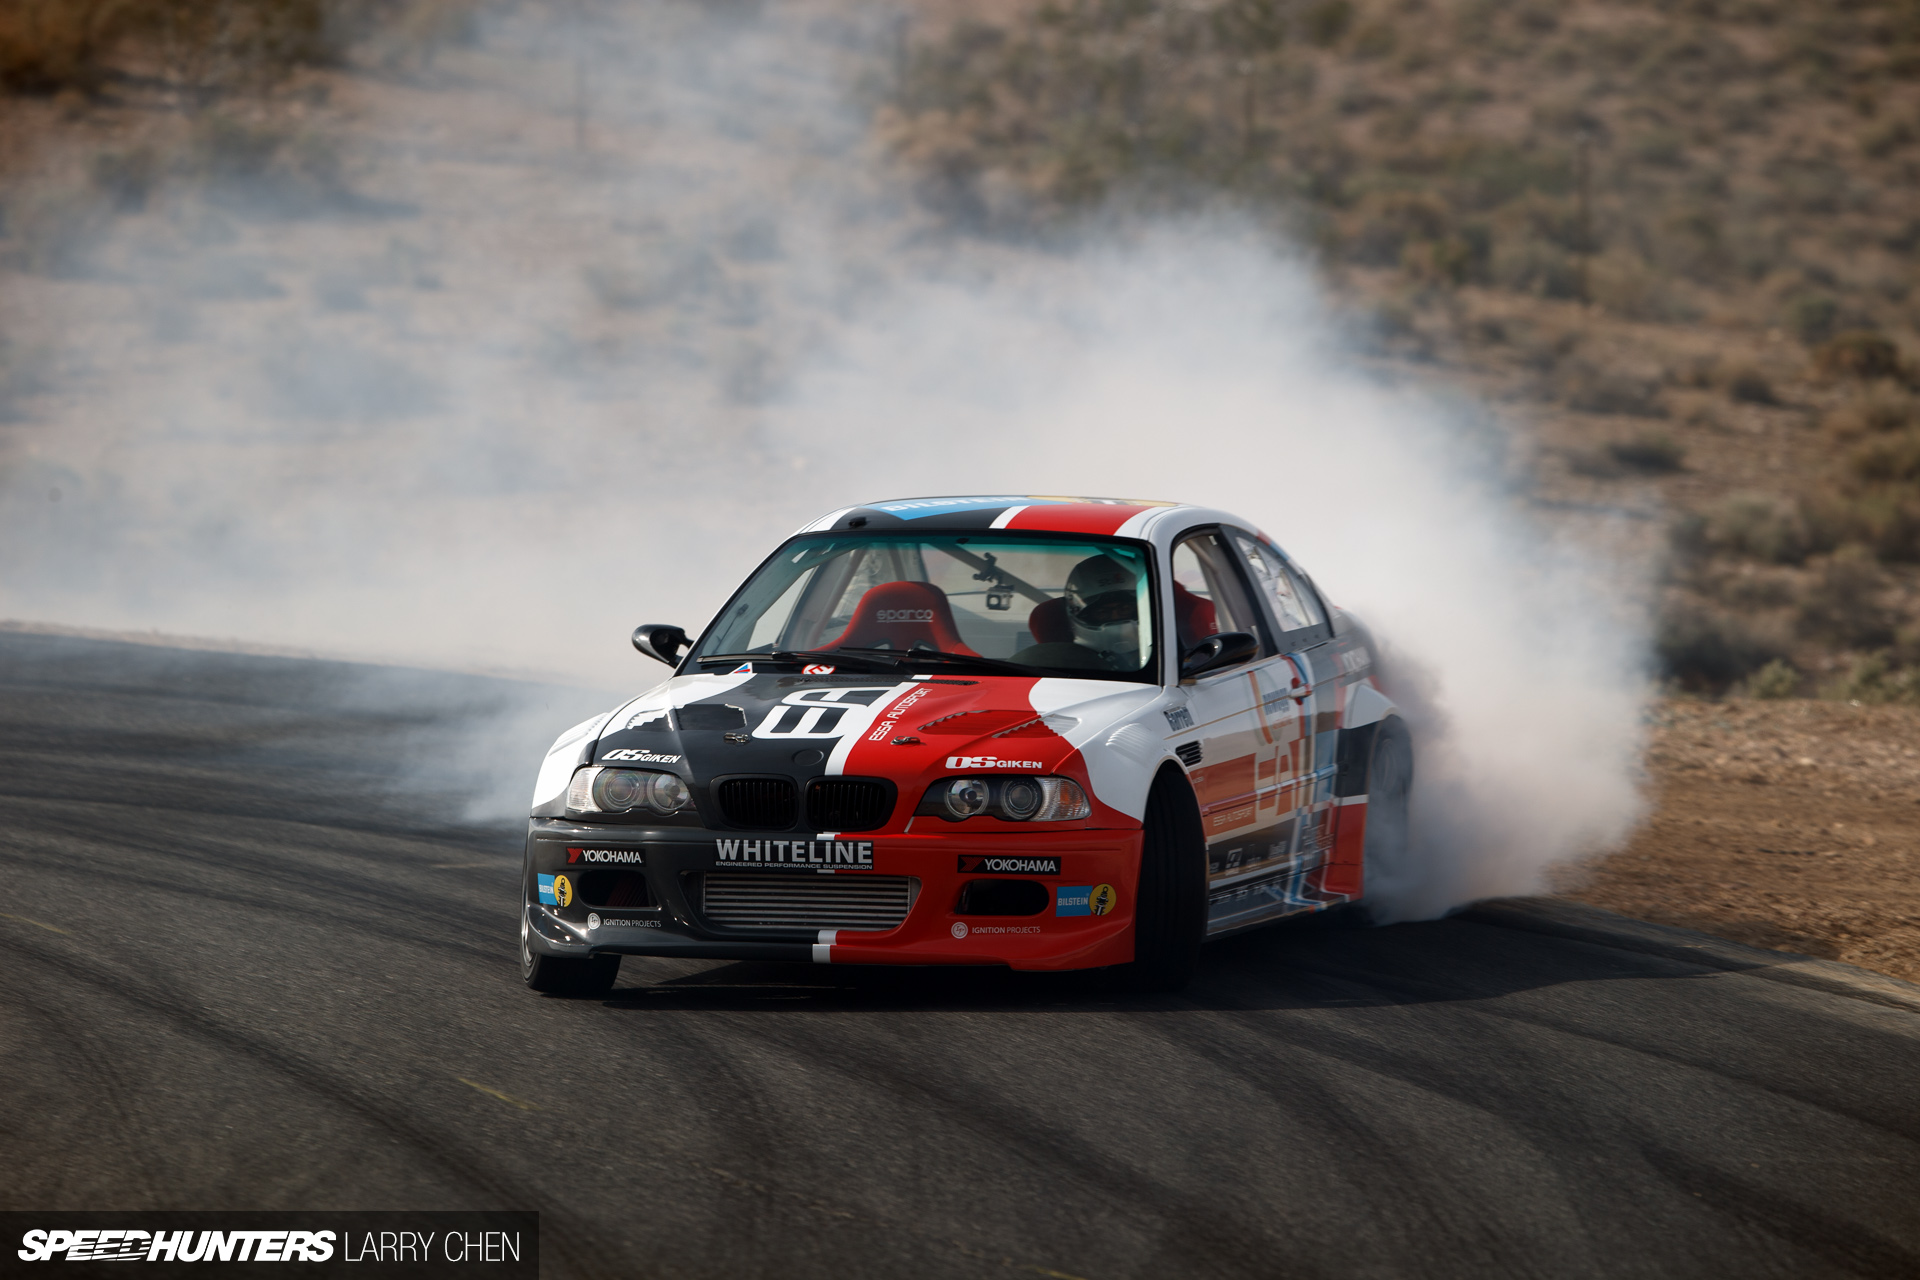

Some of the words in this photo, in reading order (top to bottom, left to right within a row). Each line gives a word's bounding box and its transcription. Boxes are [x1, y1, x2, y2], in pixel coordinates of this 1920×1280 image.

[876, 608, 934, 623] sparco
[868, 720, 897, 741] ESSA
[886, 687, 933, 720] AUTOSPORT
[582, 849, 643, 864] YOKOHAMA
[715, 838, 873, 864] WHITELINE
[715, 860, 763, 868] ENGINEERED
[764, 862, 822, 870] PERFORMANCE
[822, 863, 873, 871] SUSPENSION
[984, 858, 1057, 872] YOKOHAMA
[1057, 896, 1089, 906] BILSTEIN
[603, 918, 631, 927] IGNITION
[631, 919, 662, 928] PROJECTS
[971, 926, 1006, 934] IGNITION
[1006, 926, 1041, 934] PROJECTS
